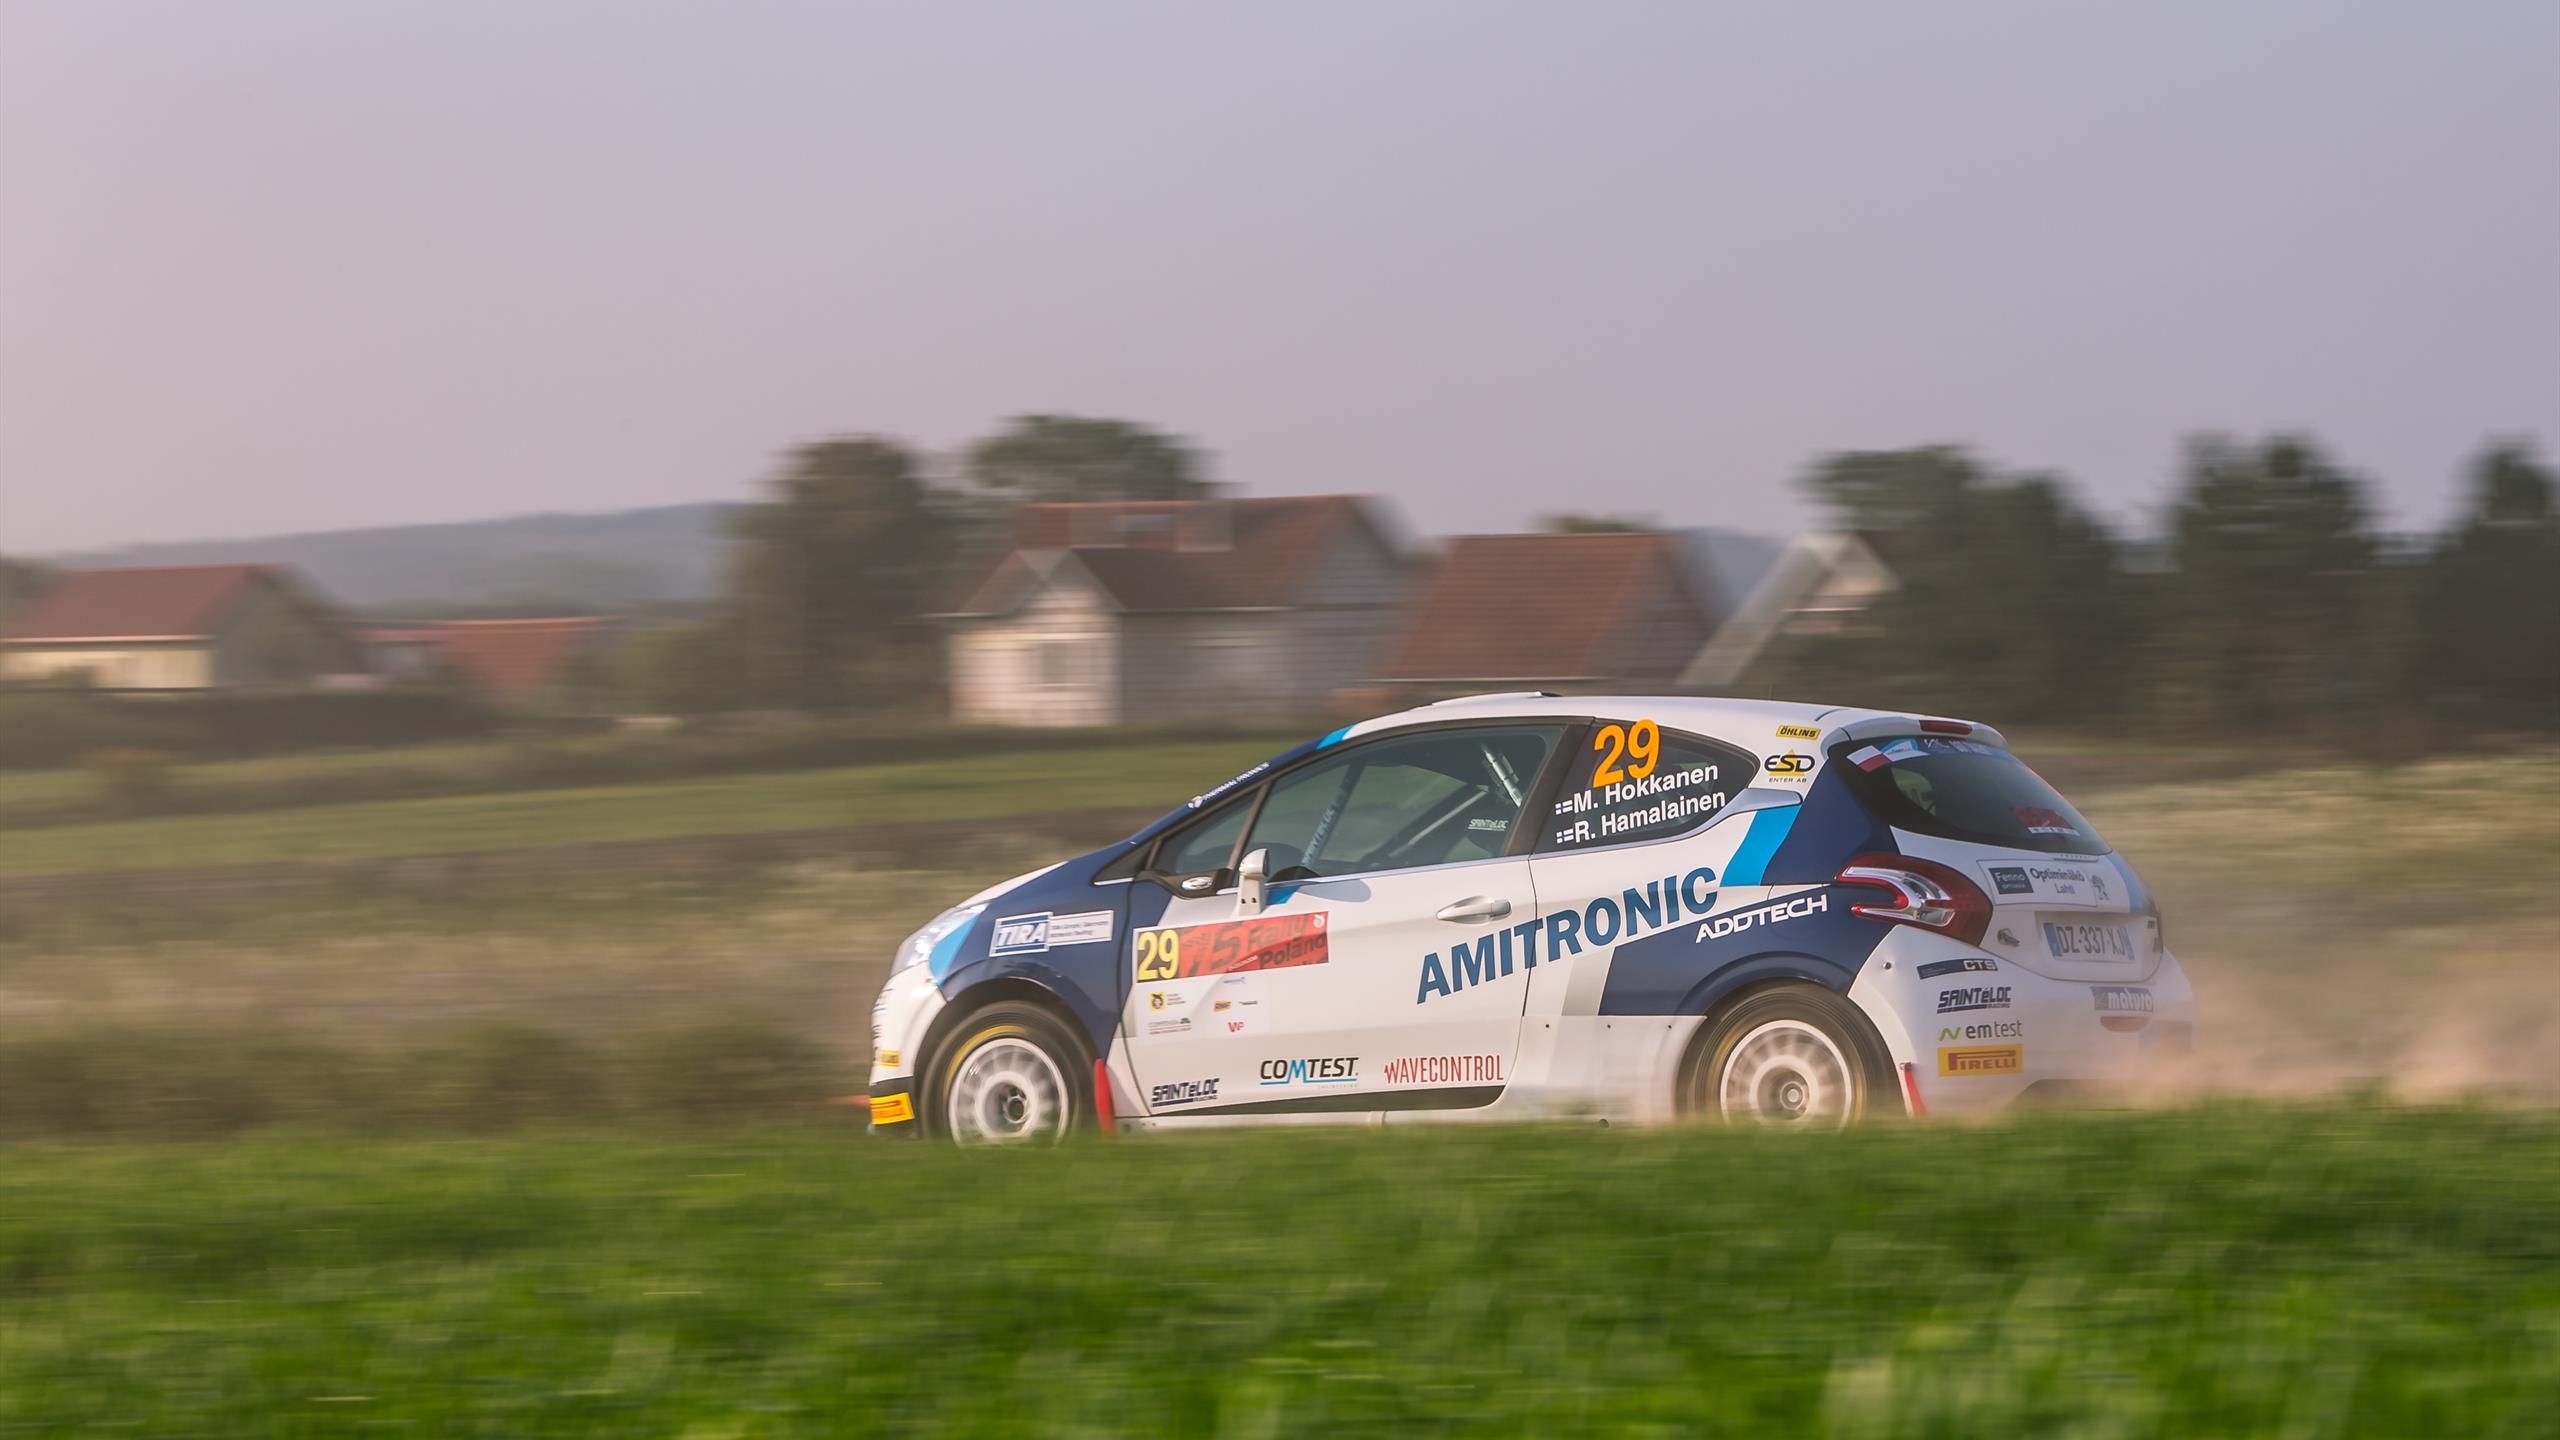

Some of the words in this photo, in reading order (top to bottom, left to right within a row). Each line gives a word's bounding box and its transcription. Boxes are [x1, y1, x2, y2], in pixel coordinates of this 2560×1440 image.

[1780, 726, 1816, 737] ÖHLINS
[1593, 719, 1660, 788] 29
[1764, 755, 1816, 772] ESD
[1574, 791, 1598, 813] M.
[1605, 764, 1719, 805] Hokkanen
[1575, 821, 1596, 843] R.
[1602, 791, 1726, 835] Hamalainen
[998, 922, 1047, 946] TIRA
[1247, 914, 1310, 953] Rally
[1417, 867, 1719, 1005] AMITRONIC
[1695, 894, 1828, 944] ADDTECH
[1137, 929, 1180, 981] 29
[1259, 932, 1329, 969] Poland
[1963, 960, 1997, 970] CTS
[1260, 1057, 1359, 1082] COMTEST
[1384, 1055, 1504, 1084] WAVECONTROL
[1948, 1050, 2017, 1071] PIRELLI
